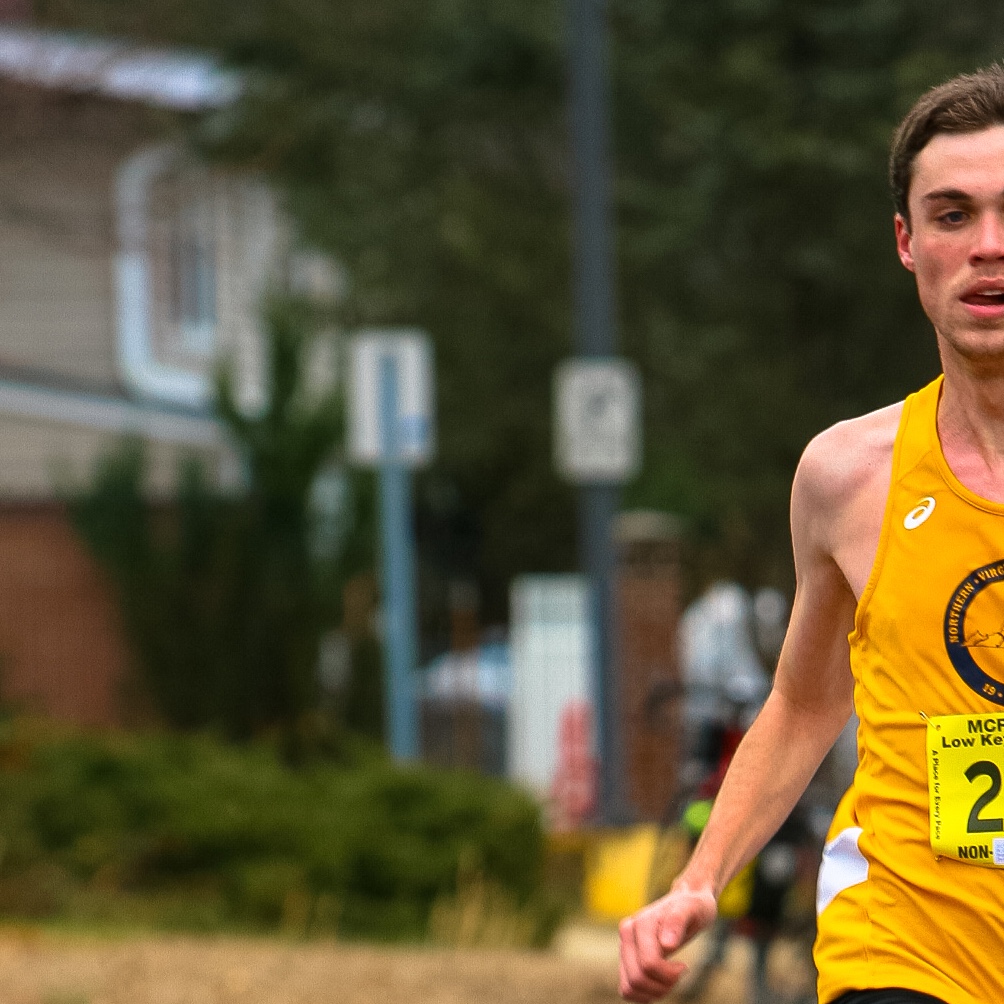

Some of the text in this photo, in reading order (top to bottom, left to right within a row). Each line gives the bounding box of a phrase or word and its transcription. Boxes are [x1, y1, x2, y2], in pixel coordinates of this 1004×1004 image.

[948, 582, 975, 643] NORTHERN
[982, 683, 996, 696] 19
[942, 736, 975, 748] Low
[934, 796, 942, 819] Every
